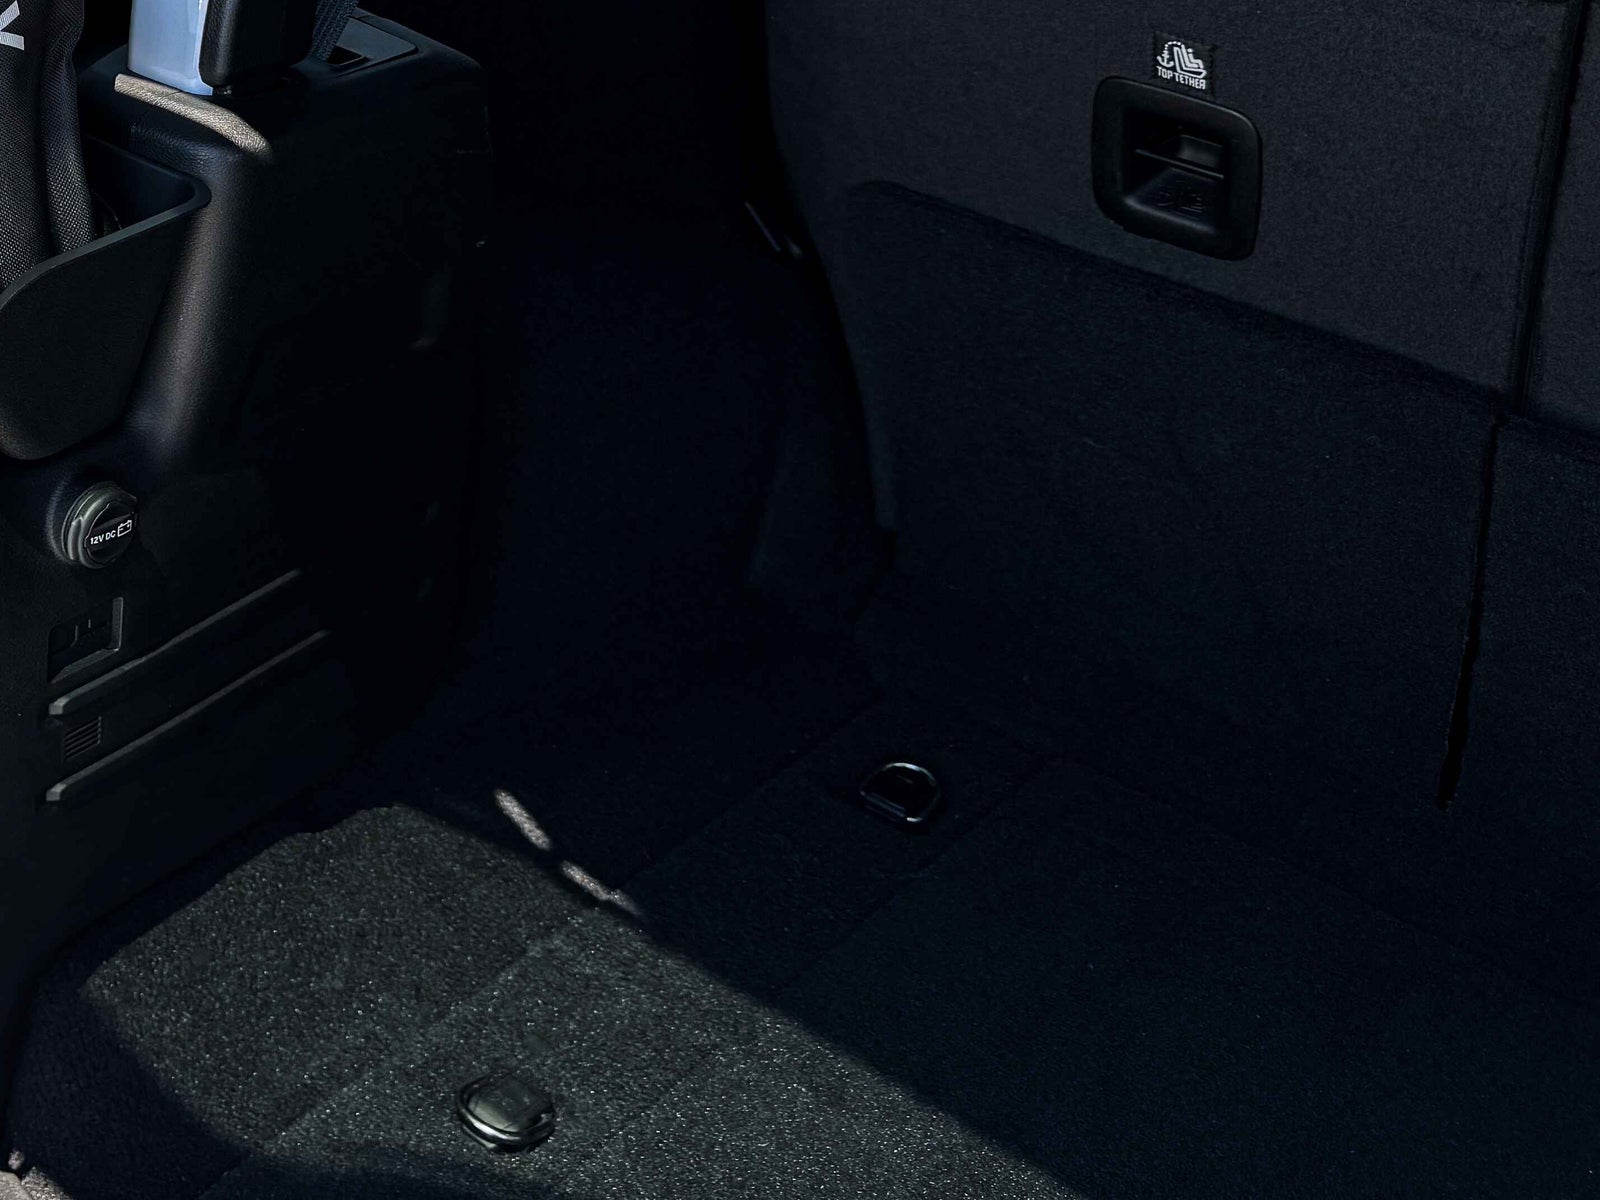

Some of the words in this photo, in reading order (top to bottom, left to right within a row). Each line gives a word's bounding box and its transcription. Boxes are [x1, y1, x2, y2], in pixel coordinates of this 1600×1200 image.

[1156, 65, 1173, 80] TOP
[1174, 72, 1206, 90] TETHER
[90, 534, 105, 545] 12V
[105, 530, 116, 541] DC
